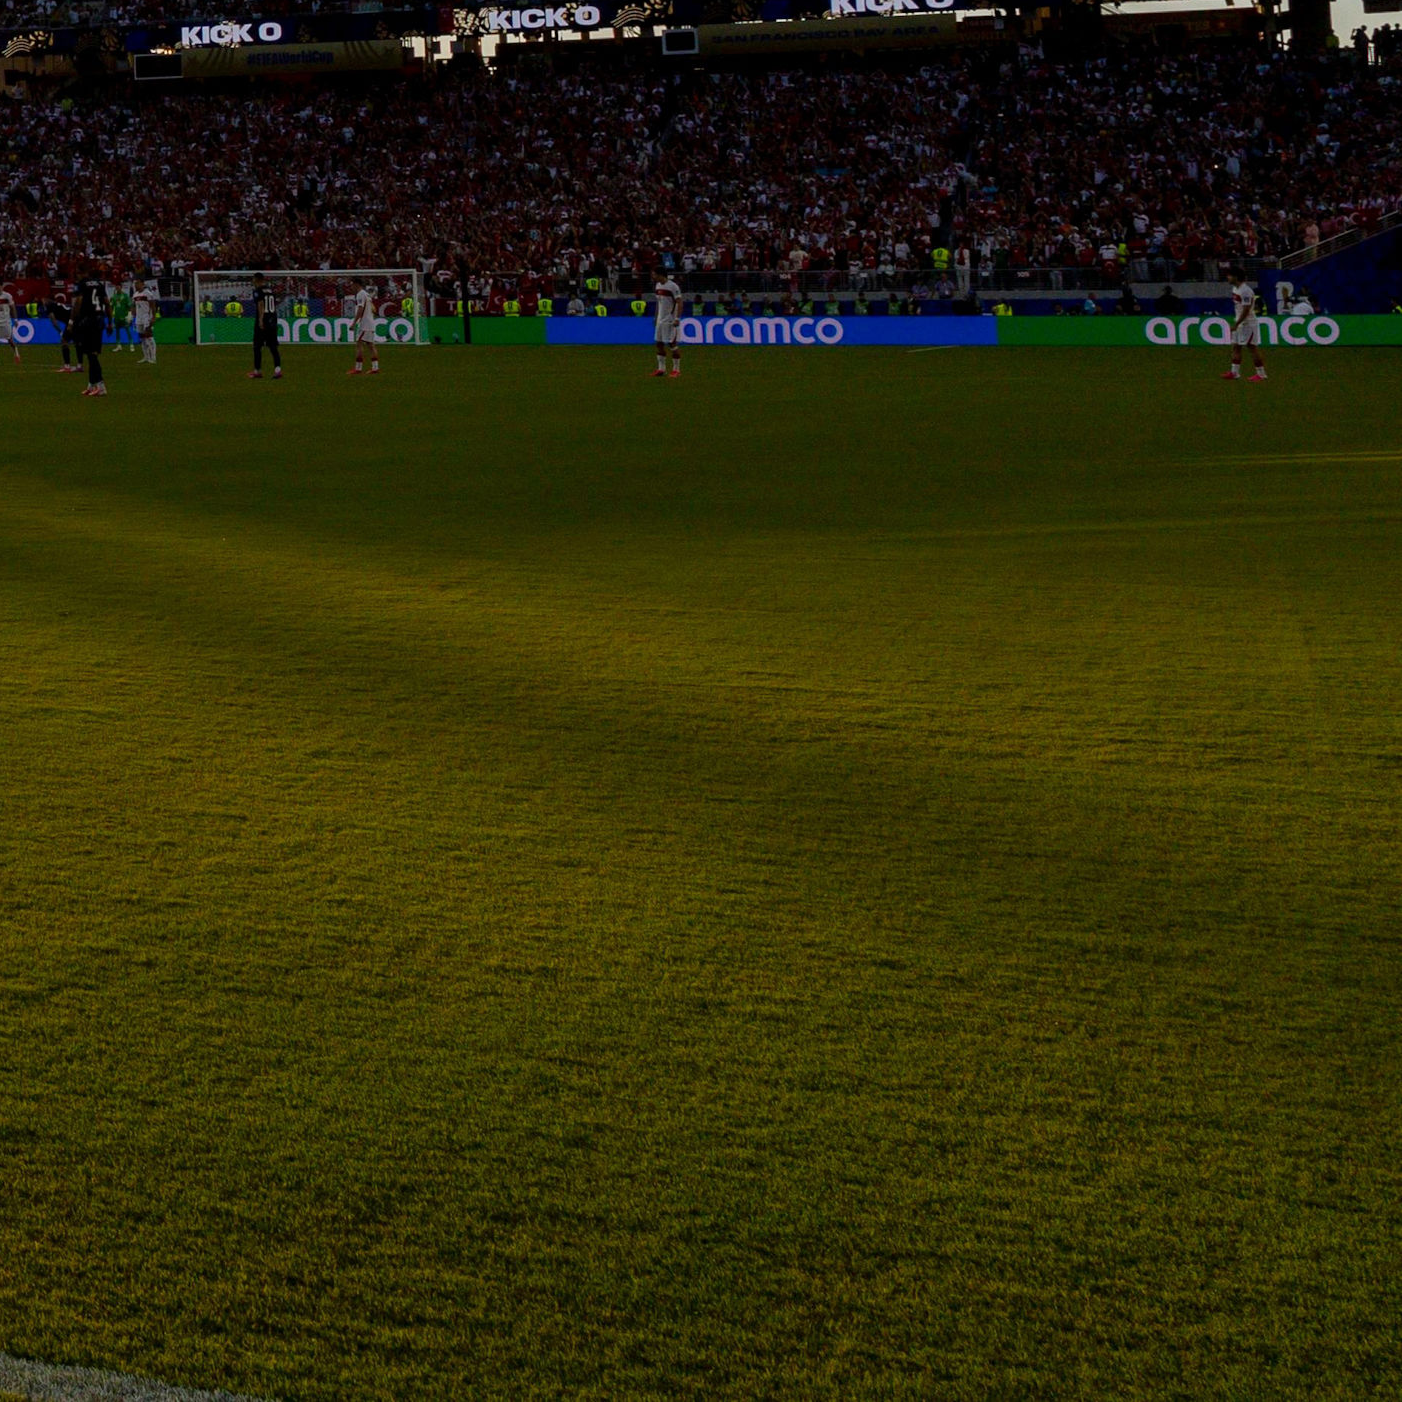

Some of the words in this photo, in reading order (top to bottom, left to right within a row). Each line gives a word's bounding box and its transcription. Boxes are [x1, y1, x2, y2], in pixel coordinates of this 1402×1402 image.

[488, 7, 570, 31] KICK
[574, 5, 601, 26] O
[181, 23, 254, 46] KICK
[257, 22, 283, 42] O
[712, 34, 747, 44] SAN
[750, 30, 849, 43] FRANCISCO
[892, 26, 940, 36] AREA
[264, 294, 275, 313] 10
[679, 317, 844, 344] aramco
